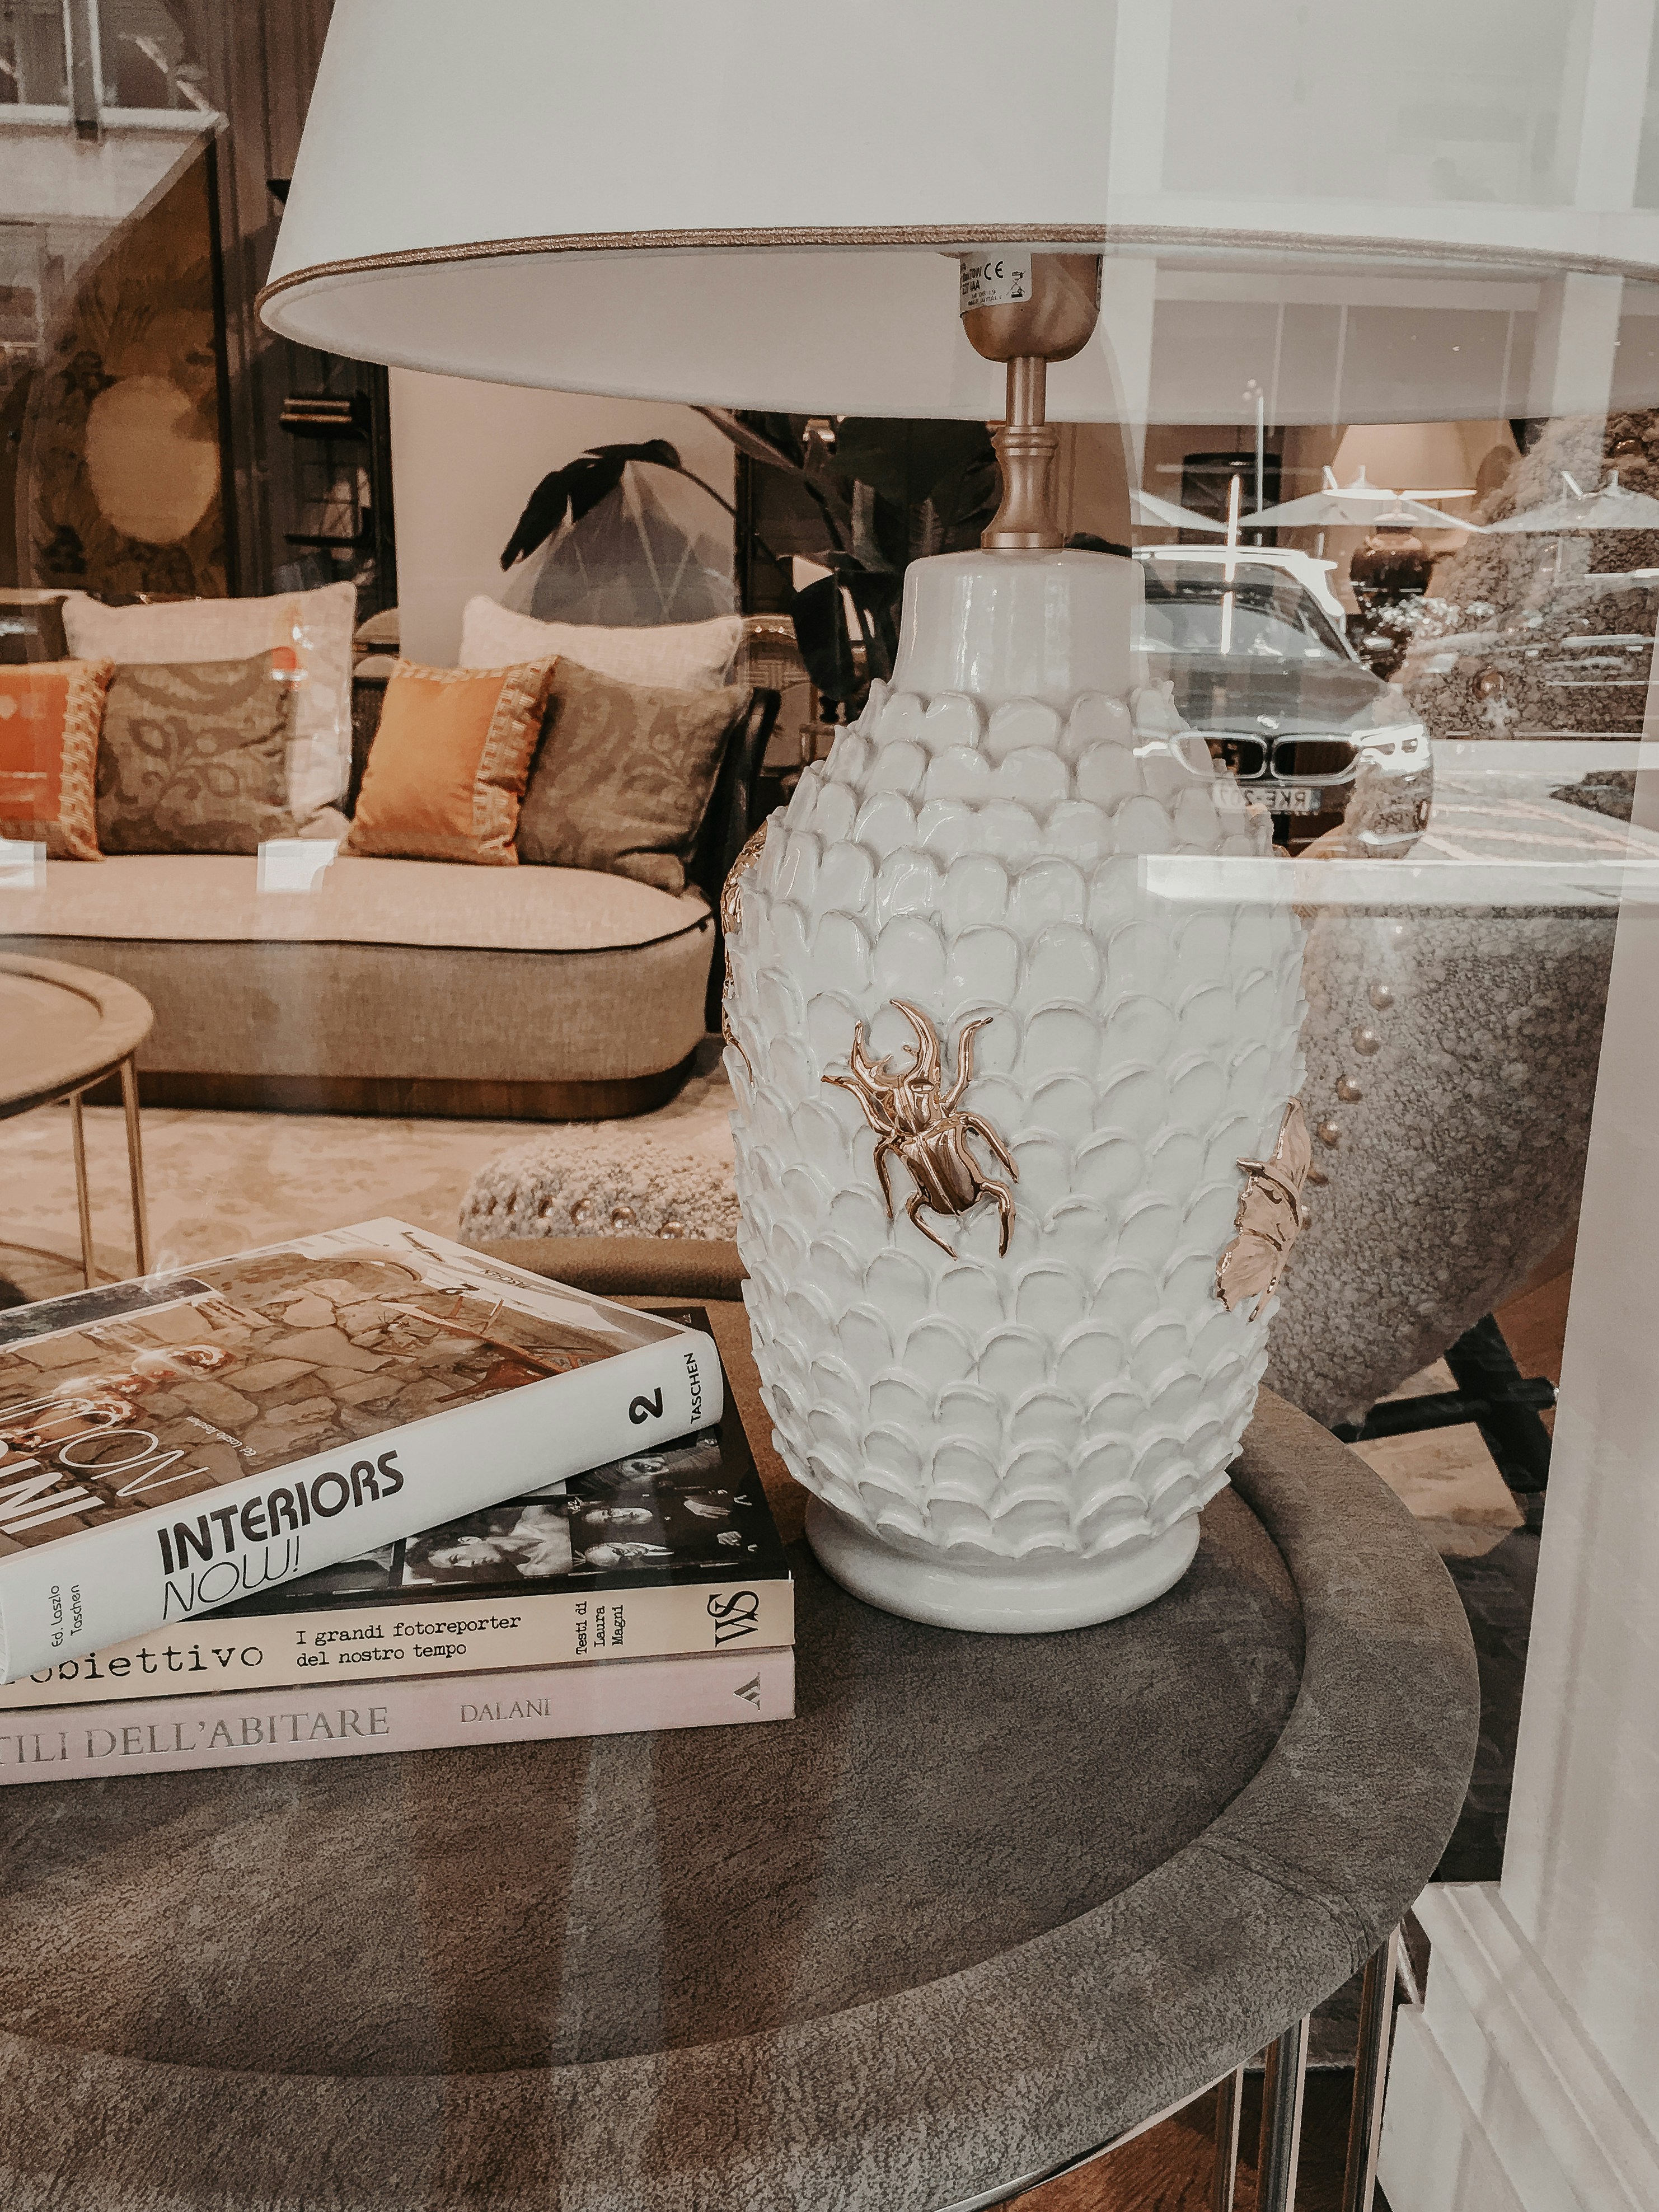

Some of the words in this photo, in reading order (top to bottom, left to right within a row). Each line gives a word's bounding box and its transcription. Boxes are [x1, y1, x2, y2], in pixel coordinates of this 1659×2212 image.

[983, 261, 1004, 280] CE
[438, 1283, 480, 1296] 2
[629, 1386, 663, 1424] 2
[683, 1352, 702, 1424] TASCHEN
[157, 1450, 405, 1576] INTERIORS
[163, 1535, 300, 1620] NOW!
[48, 1585, 63, 1626] Laszlo
[70, 1584, 82, 1636] Taschen
[575, 1601, 587, 1615] di
[51, 1627, 63, 1647] Ed.
[296, 1630, 307, 1645] I
[315, 1624, 385, 1647] grandi
[392, 1615, 522, 1637] fotoreporter
[575, 1620, 588, 1655] Testi
[594, 1605, 606, 1648] Laura
[612, 1604, 626, 1646] Magni
[297, 1651, 330, 1667] del
[338, 1647, 405, 1664] nostro
[413, 1643, 467, 1658] tempo
[460, 1698, 551, 1723] DALANI
[85, 1707, 390, 1759] DELL'ABITARE
